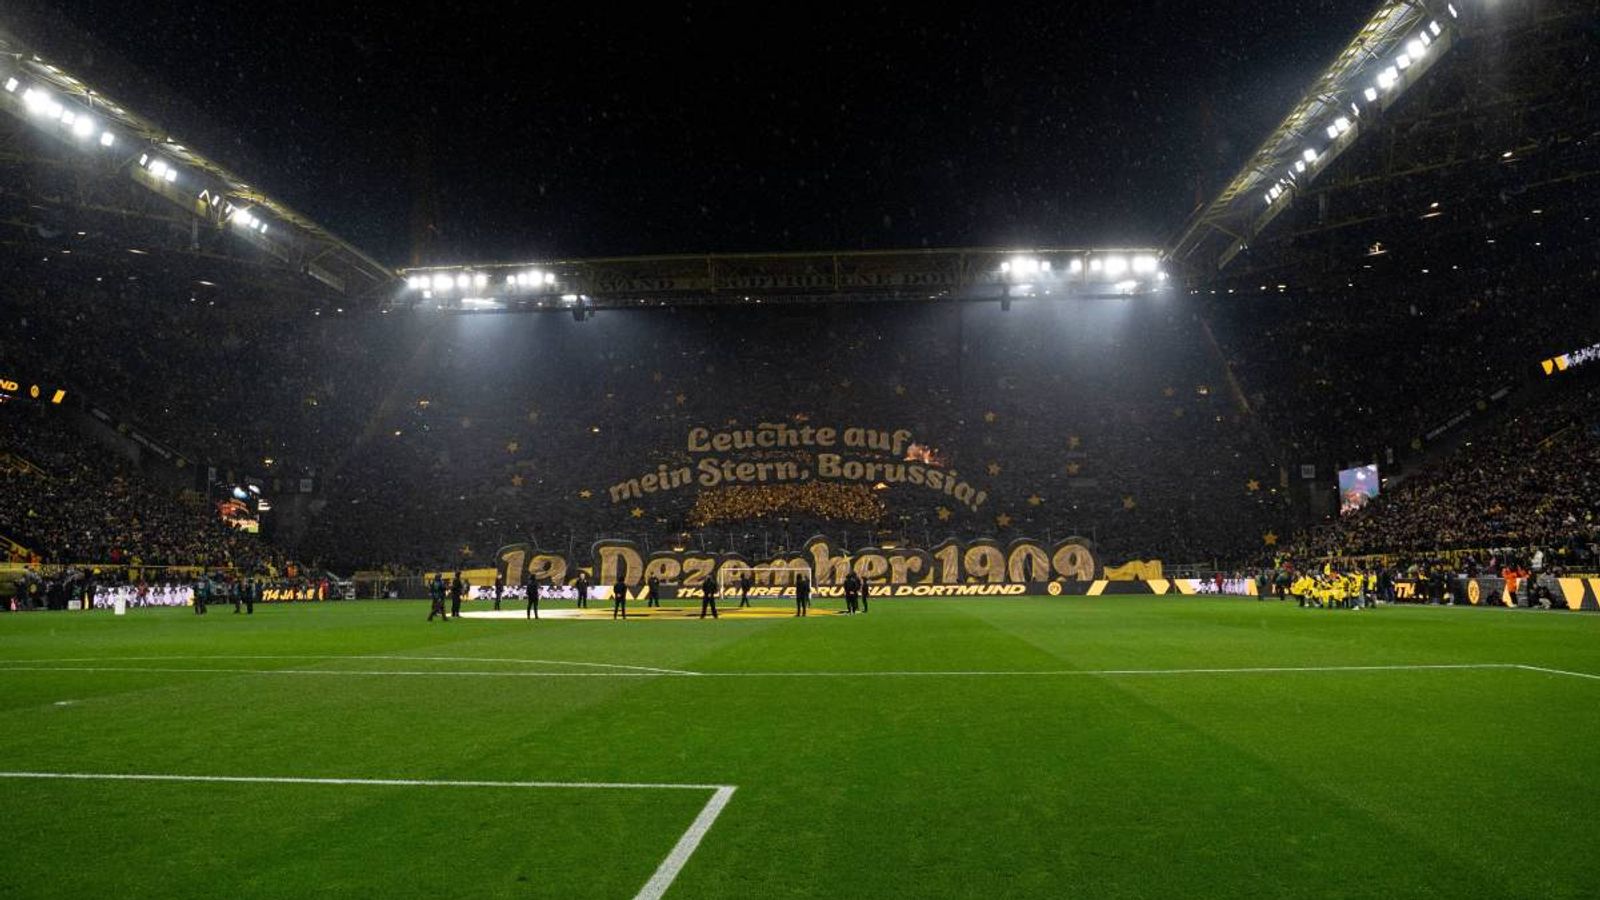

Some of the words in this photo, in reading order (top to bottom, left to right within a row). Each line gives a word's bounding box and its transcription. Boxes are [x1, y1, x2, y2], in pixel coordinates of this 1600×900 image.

[843, 427, 913, 455] auf
[608, 463, 693, 503] mein
[698, 456, 810, 488] Stern,
[816, 453, 989, 513] Borussia!
[894, 584, 1026, 597] DORTMUND
